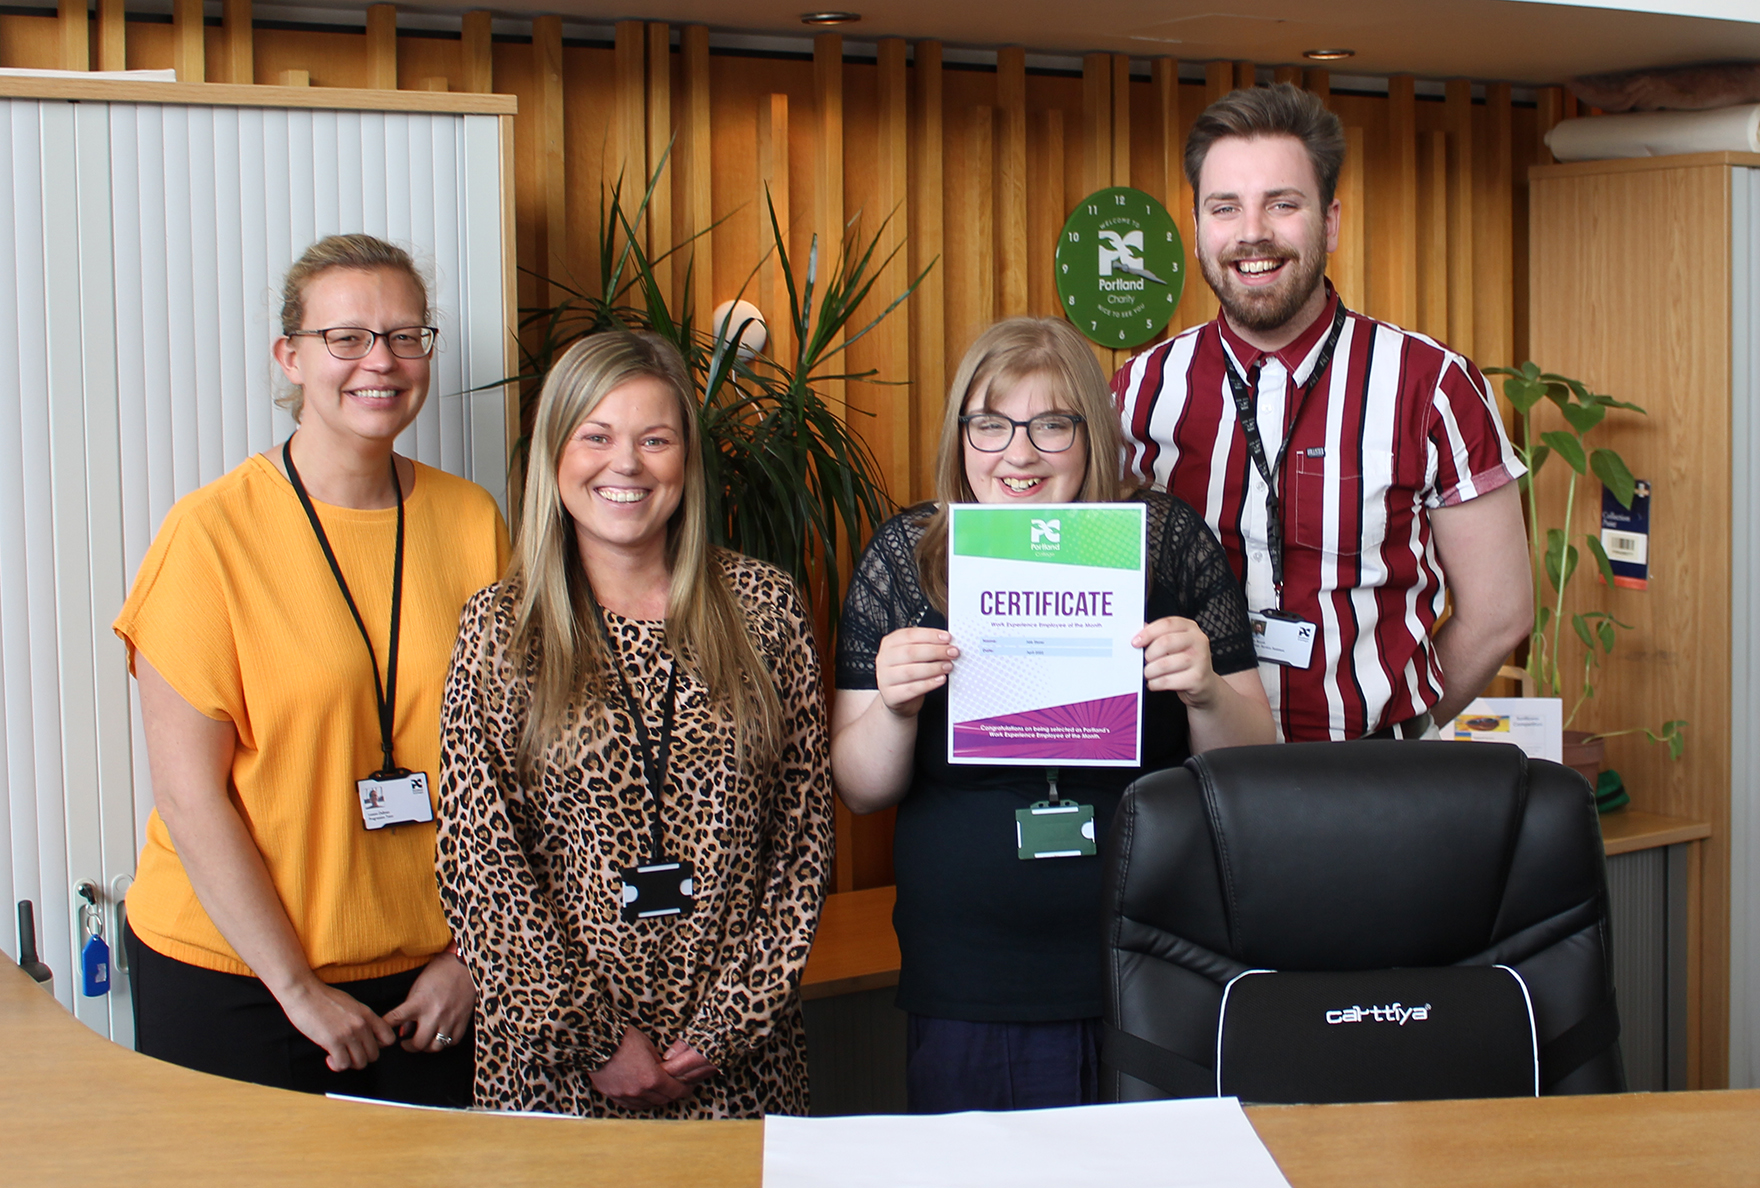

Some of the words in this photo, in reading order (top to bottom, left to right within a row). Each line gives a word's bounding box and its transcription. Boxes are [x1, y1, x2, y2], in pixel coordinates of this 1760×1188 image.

[1114, 195, 1126, 206] 12
[1088, 205, 1098, 215] 11
[1099, 217, 1130, 230] WELCOME
[1132, 220, 1140, 229] TO
[1068, 232, 1080, 242] 10
[1166, 231, 1172, 242] 2
[1062, 264, 1069, 274] 9
[1172, 262, 1178, 272] 3
[1099, 278, 1144, 291] Portland
[1069, 295, 1075, 305] 8
[1107, 294, 1135, 304] Charity
[1166, 293, 1173, 303] 4
[1097, 304, 1111, 316] NICE
[1133, 303, 1145, 314] YOU
[1091, 321, 1097, 331] 7
[1146, 319, 1153, 329] 5
[1119, 330, 1125, 340] 6
[1031, 543, 1060, 551] Portland
[980, 591, 1114, 616] CERTIFICATE
[980, 724, 1024, 732] Congratulations
[1033, 725, 1049, 733] being
[1083, 726, 1111, 734] Portland's
